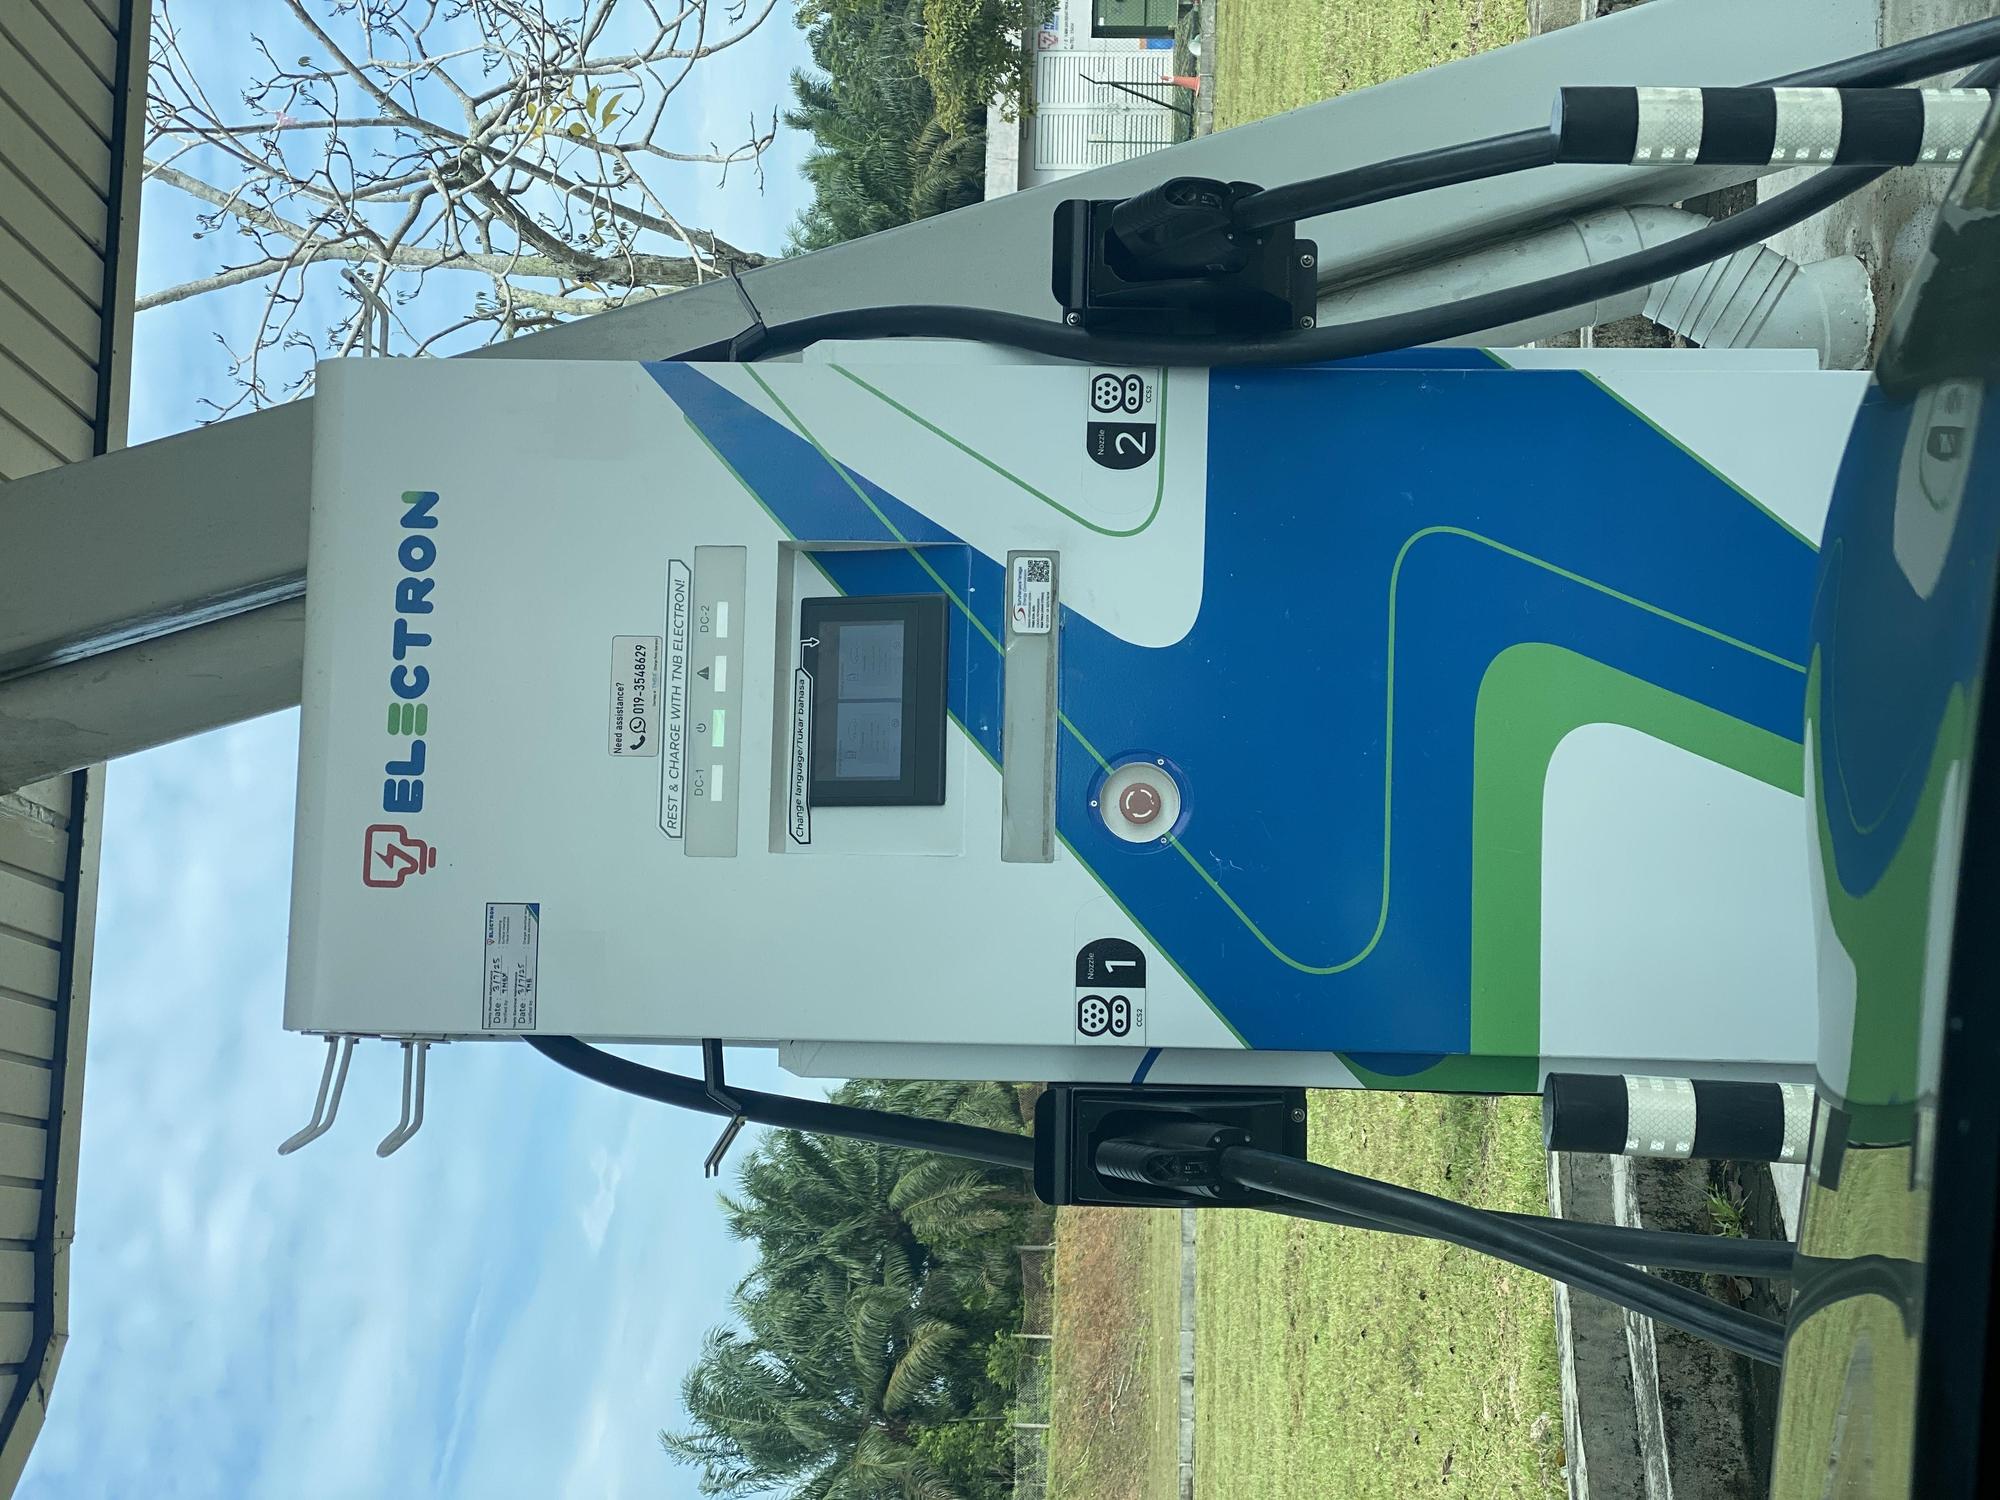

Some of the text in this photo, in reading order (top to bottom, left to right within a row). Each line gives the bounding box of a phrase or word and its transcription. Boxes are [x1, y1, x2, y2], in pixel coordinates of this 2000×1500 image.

[1115, 432, 1146, 455] 2
[699, 605, 710, 633] DC-2
[383, 490, 440, 813] ELECTRON
[633, 644, 646, 714] 019-3548629
[614, 682, 624, 754] Need assistance?
[667, 579, 685, 829] REST & CHARGE WITH TNB ELECTRON!
[694, 768, 704, 797] DC-1
[795, 799, 804, 838] Change
[1105, 960, 1136, 973] 1
[493, 1003, 501, 1023] Date
[518, 1003, 526, 1024] Date
